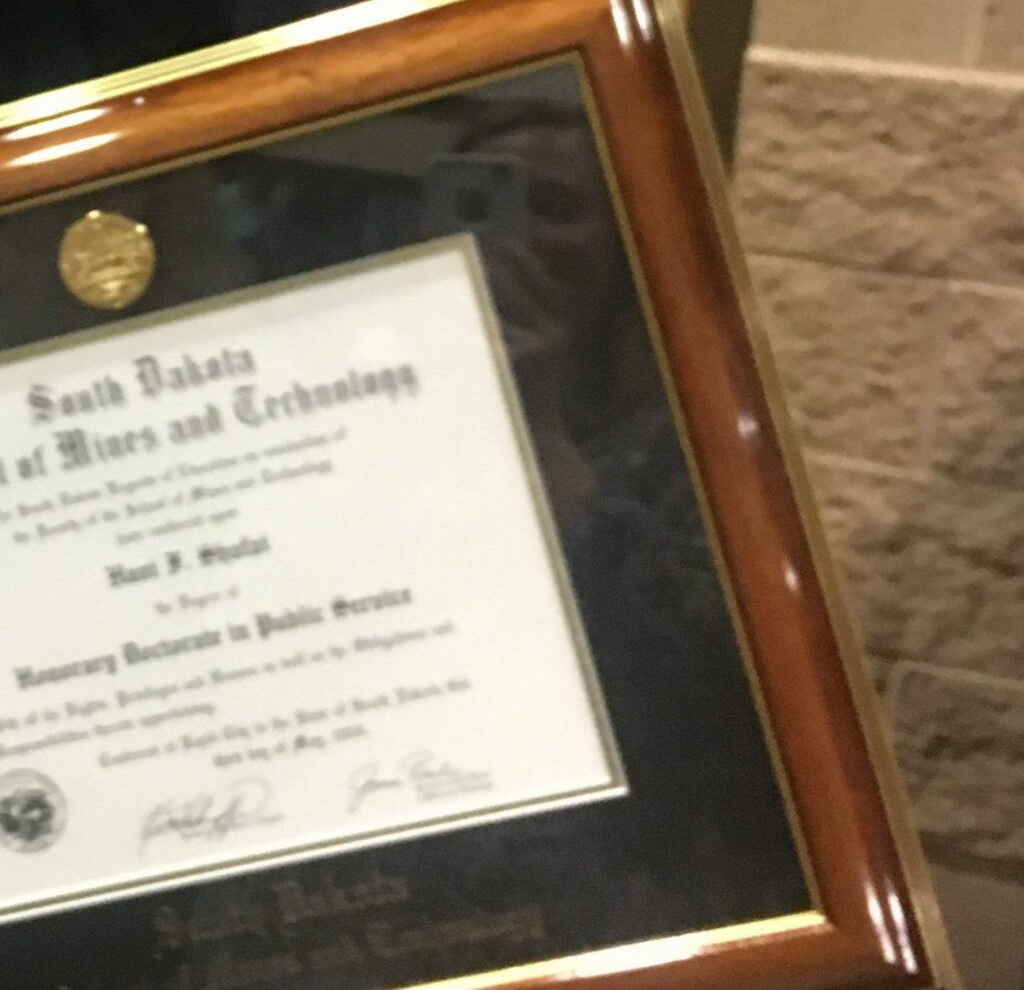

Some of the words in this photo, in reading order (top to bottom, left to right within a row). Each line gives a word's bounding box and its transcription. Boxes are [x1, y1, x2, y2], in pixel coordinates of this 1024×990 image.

[14, 445, 47, 480] of
[52, 425, 159, 471] Mines
[167, 402, 224, 444] and
[232, 363, 419, 428] Technology
[25, 374, 126, 425] South
[131, 348, 256, 399] Dakota
